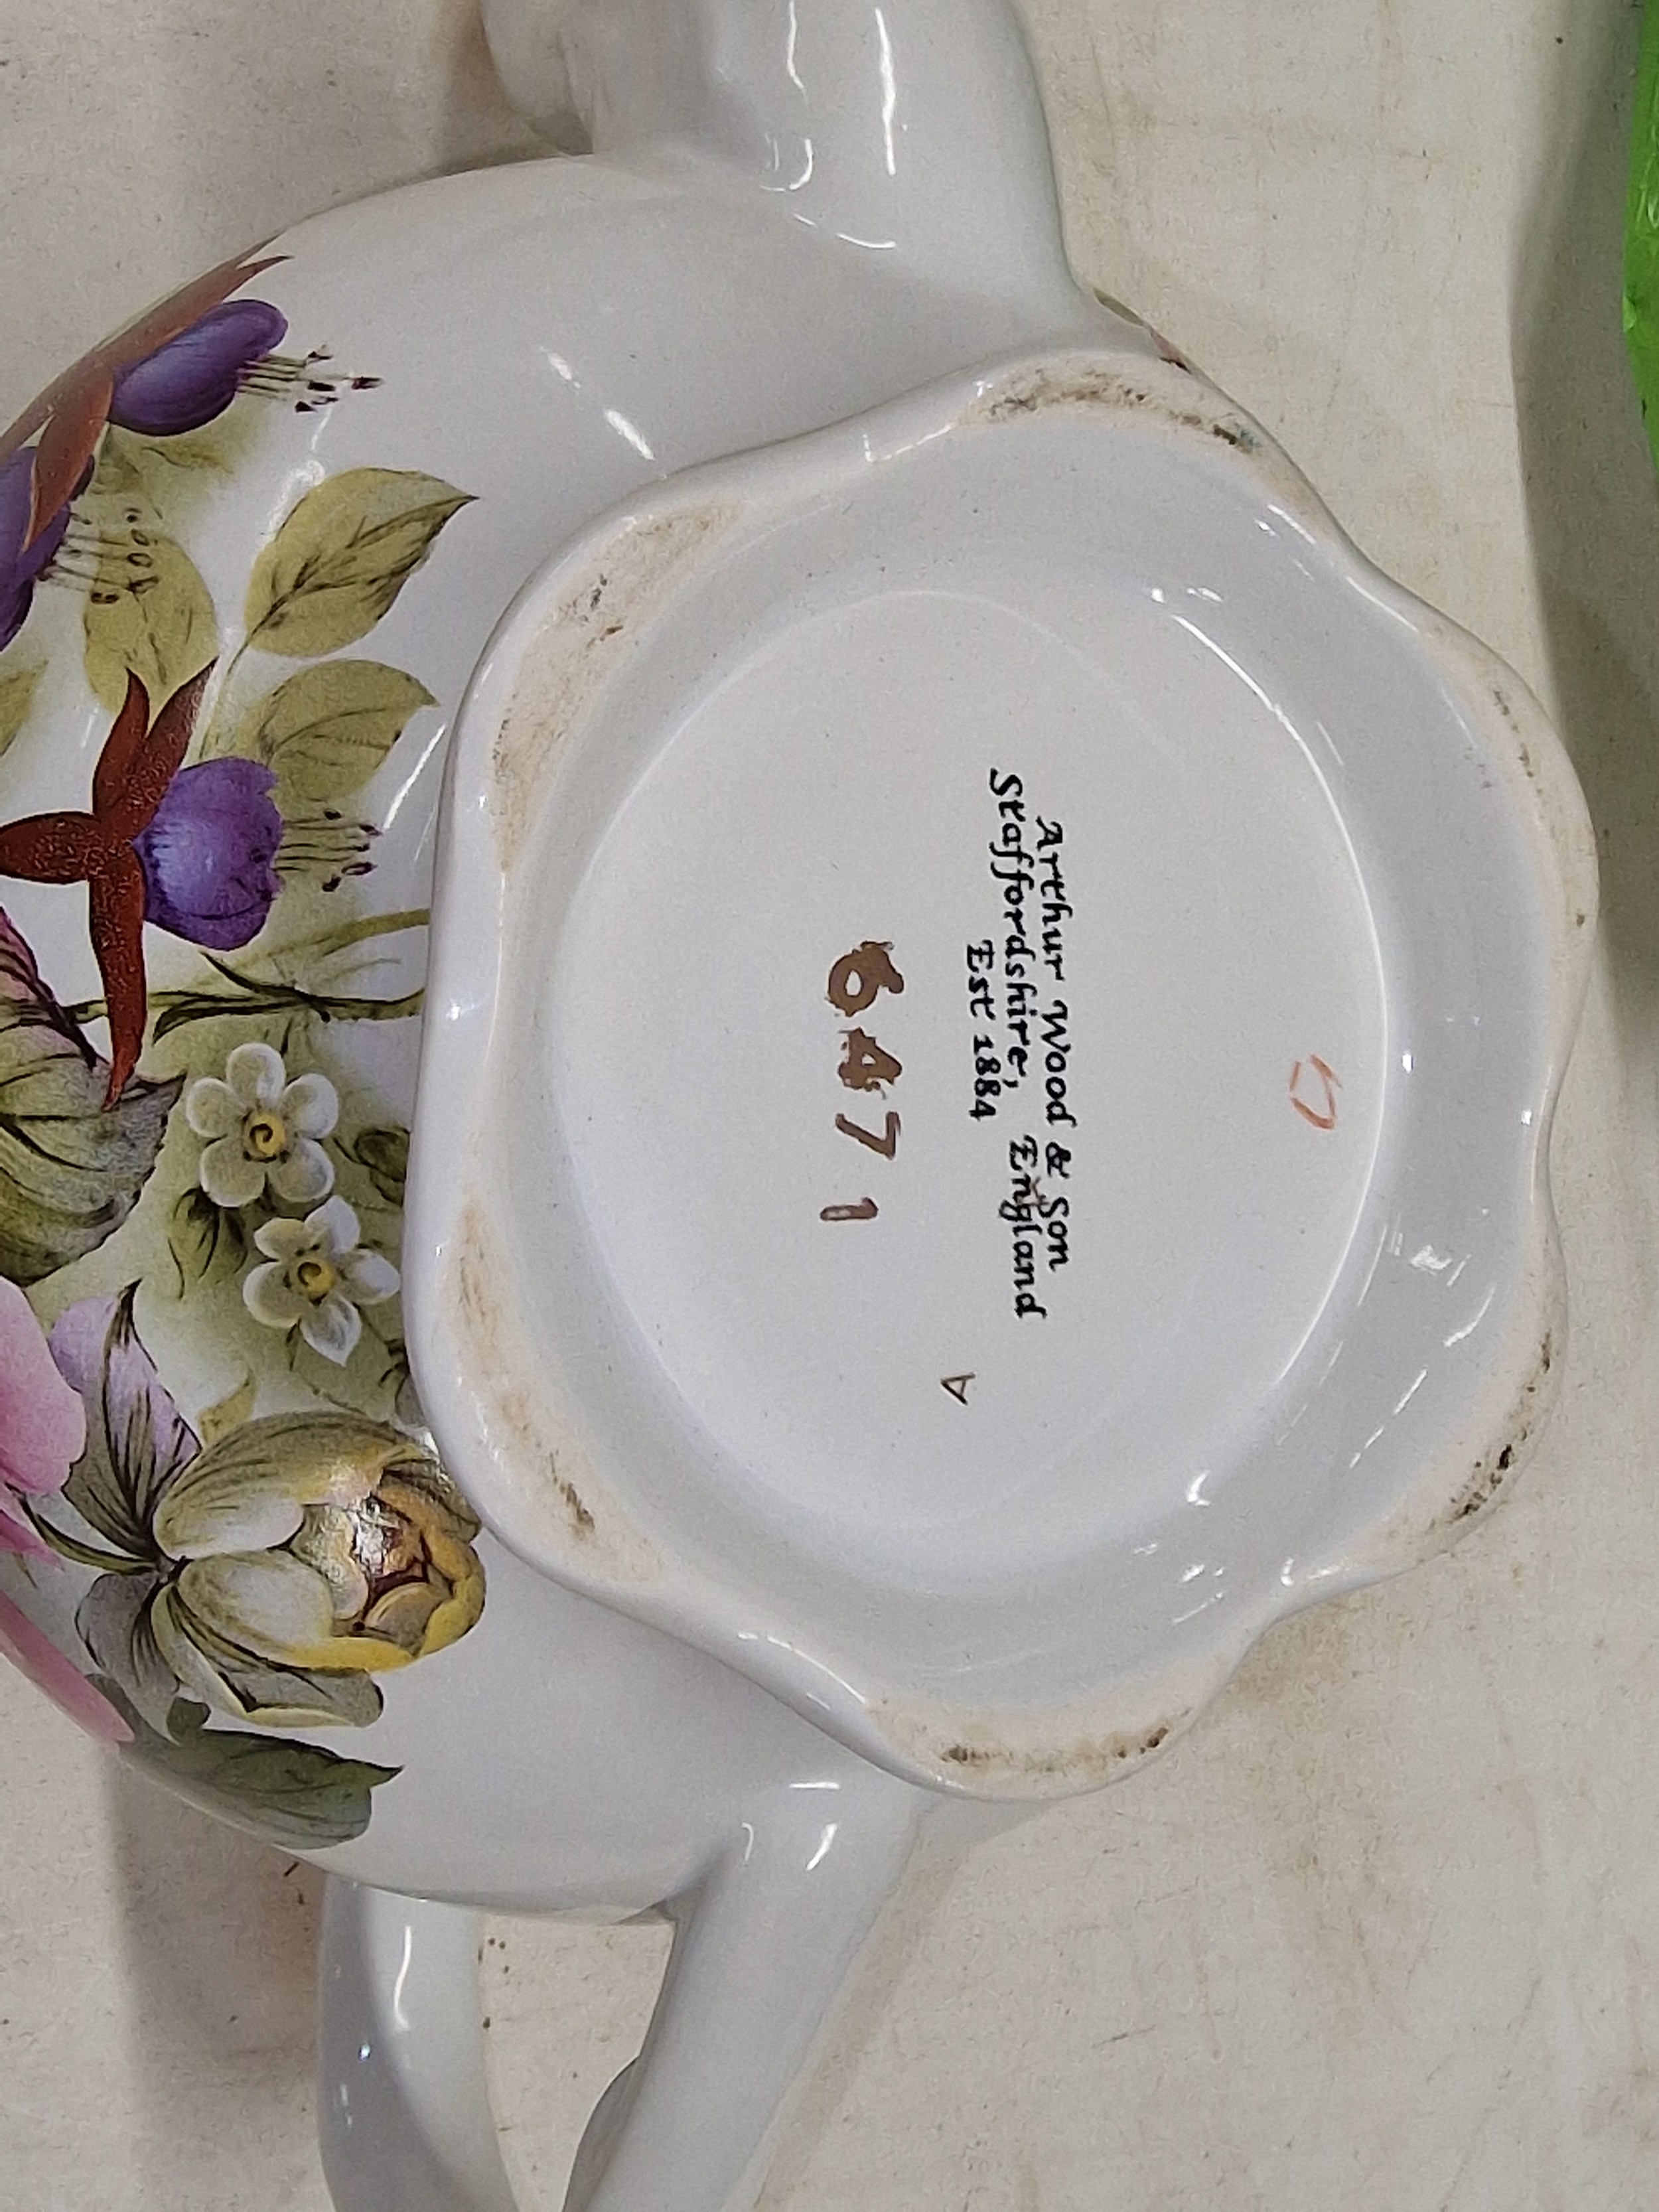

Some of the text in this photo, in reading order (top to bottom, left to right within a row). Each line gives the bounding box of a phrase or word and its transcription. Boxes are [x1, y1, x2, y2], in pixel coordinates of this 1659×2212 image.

[966, 938, 1002, 1122] Est 1884
[988, 767, 1048, 1320] Staffordshire, England
[1034, 814, 1078, 1273] Arthur Wood & Son
